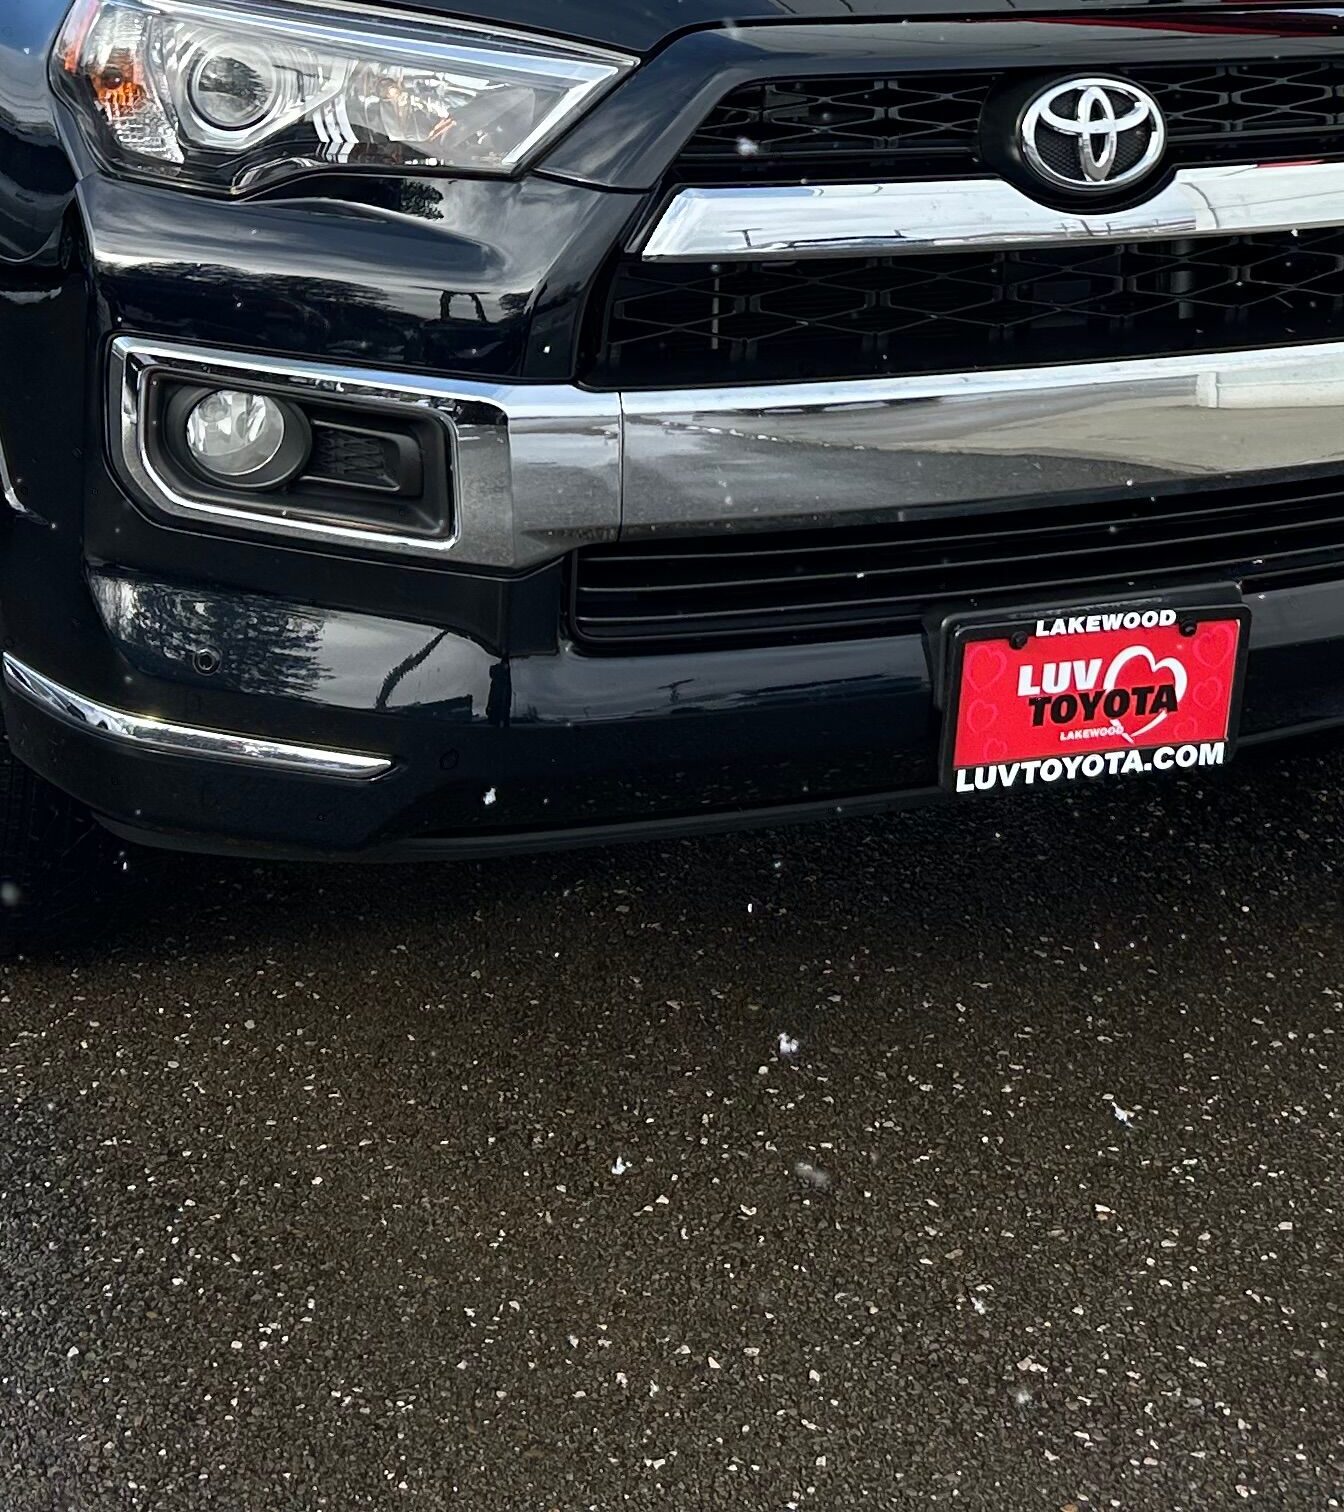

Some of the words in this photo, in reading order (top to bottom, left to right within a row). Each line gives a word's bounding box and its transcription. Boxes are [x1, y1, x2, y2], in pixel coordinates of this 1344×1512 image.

[1035, 609, 1177, 638] LAKEWOOD
[1017, 658, 1104, 696] LUV
[1028, 683, 1179, 728] TOYOTA
[1059, 724, 1125, 742] LAKEWOOD
[955, 741, 1226, 794] LUVTOYOTA.COM
